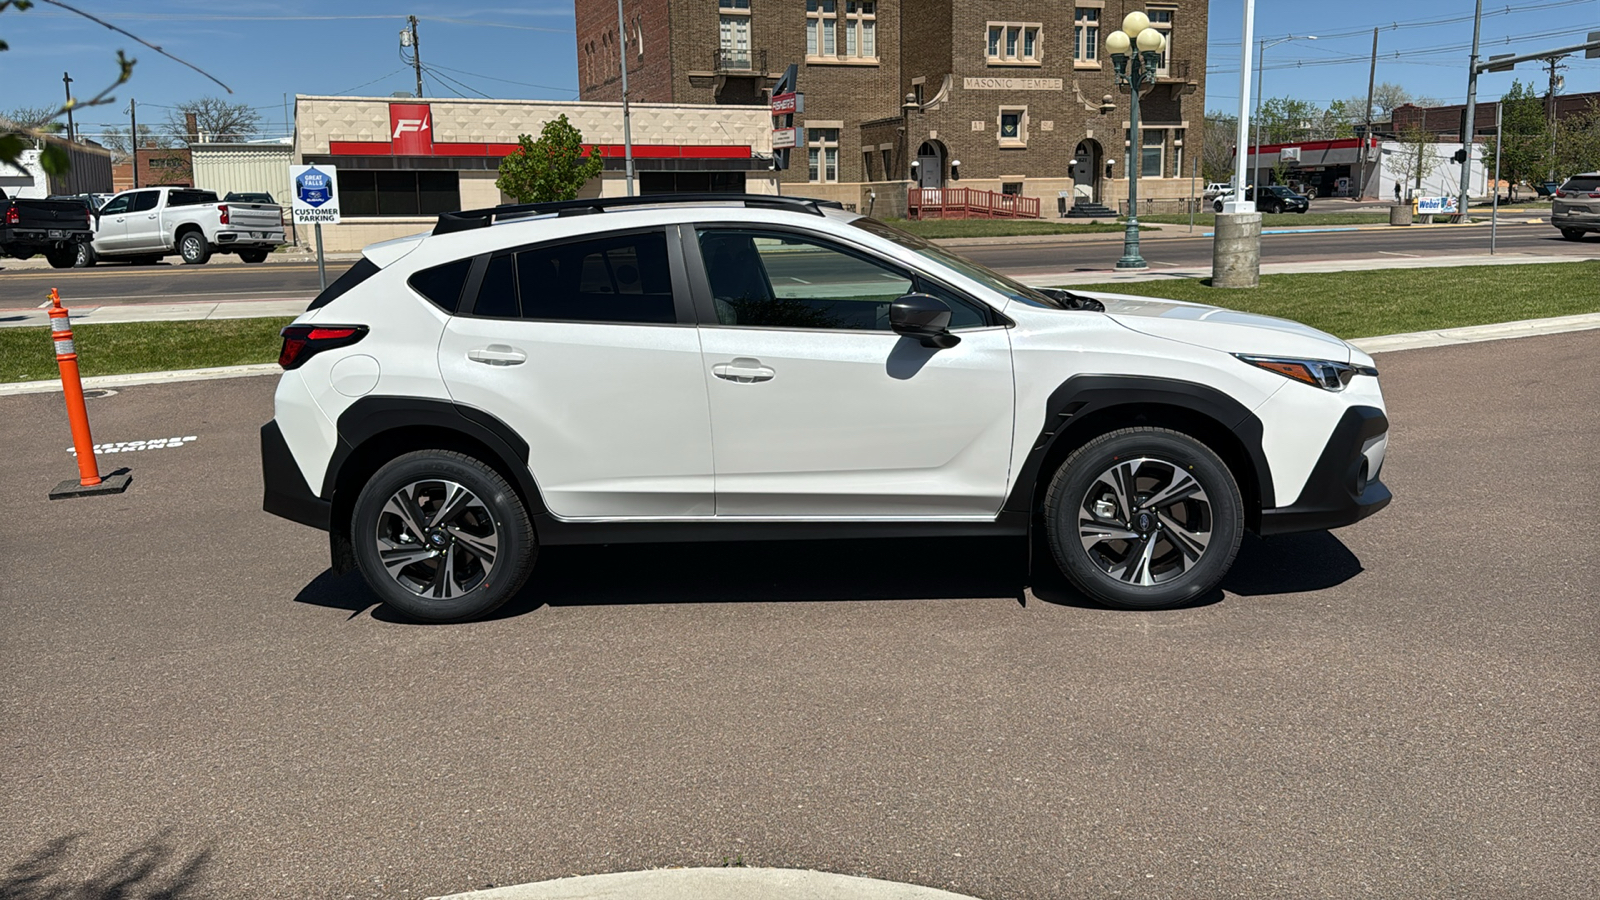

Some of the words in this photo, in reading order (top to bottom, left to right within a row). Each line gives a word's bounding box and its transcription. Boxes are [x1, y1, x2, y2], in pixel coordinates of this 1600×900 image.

[965, 78, 1013, 88] MASONIC
[1021, 79, 1061, 89] TEMPLE
[1419, 198, 1440, 209] Weber
[294, 208, 339, 216] CUSTOMER
